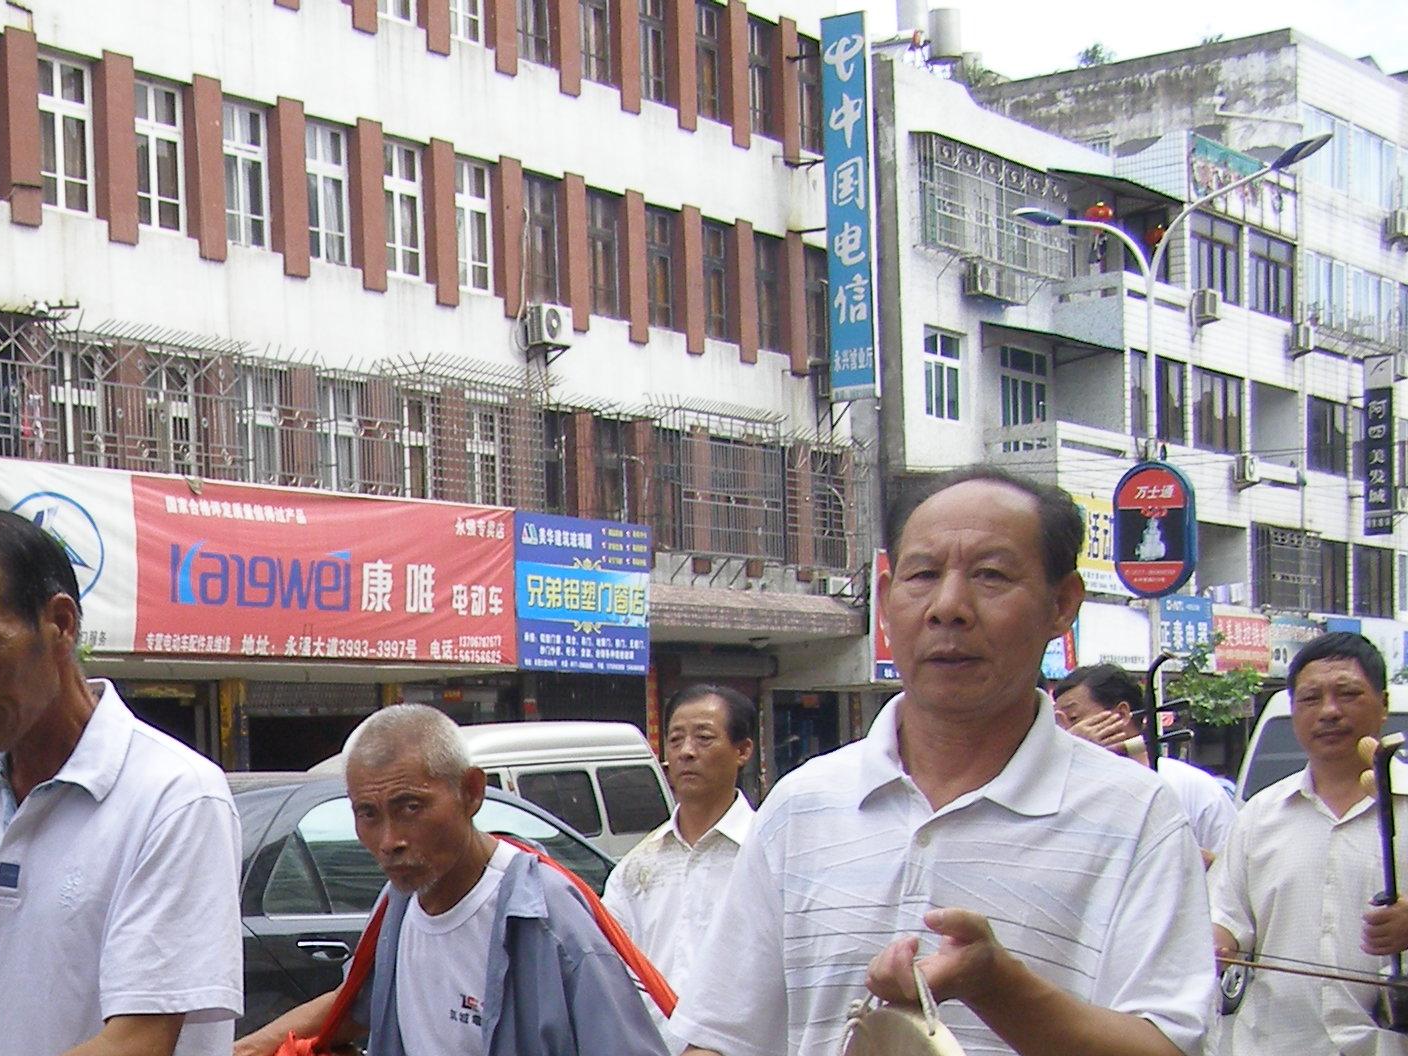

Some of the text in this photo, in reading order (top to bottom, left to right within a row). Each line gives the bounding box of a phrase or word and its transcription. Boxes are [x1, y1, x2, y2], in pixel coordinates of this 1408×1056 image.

[829, 92, 869, 324] 中国电信
[1134, 485, 1175, 499] 万士通
[361, 559, 503, 616] 康唯 电动车
[527, 574, 645, 615] 兄弟铝塑门窗店
